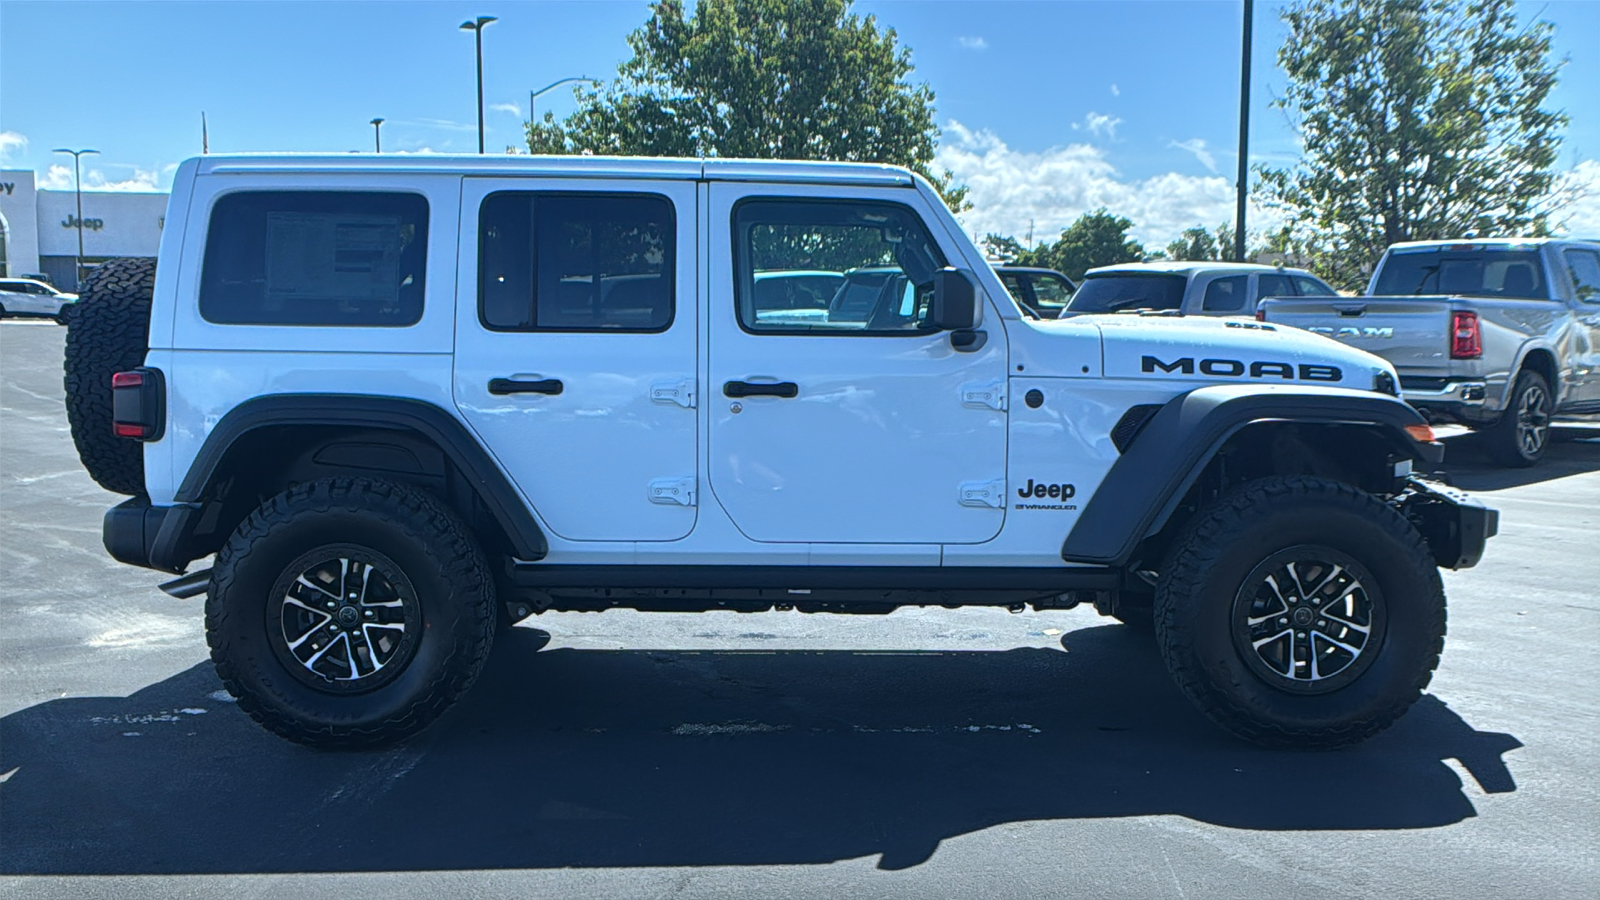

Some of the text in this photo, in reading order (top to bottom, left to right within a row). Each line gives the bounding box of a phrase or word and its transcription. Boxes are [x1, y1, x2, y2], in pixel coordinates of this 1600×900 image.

[61, 214, 104, 231] Jeep
[1141, 355, 1343, 382] MOAB
[1018, 479, 1076, 502] Jeep
